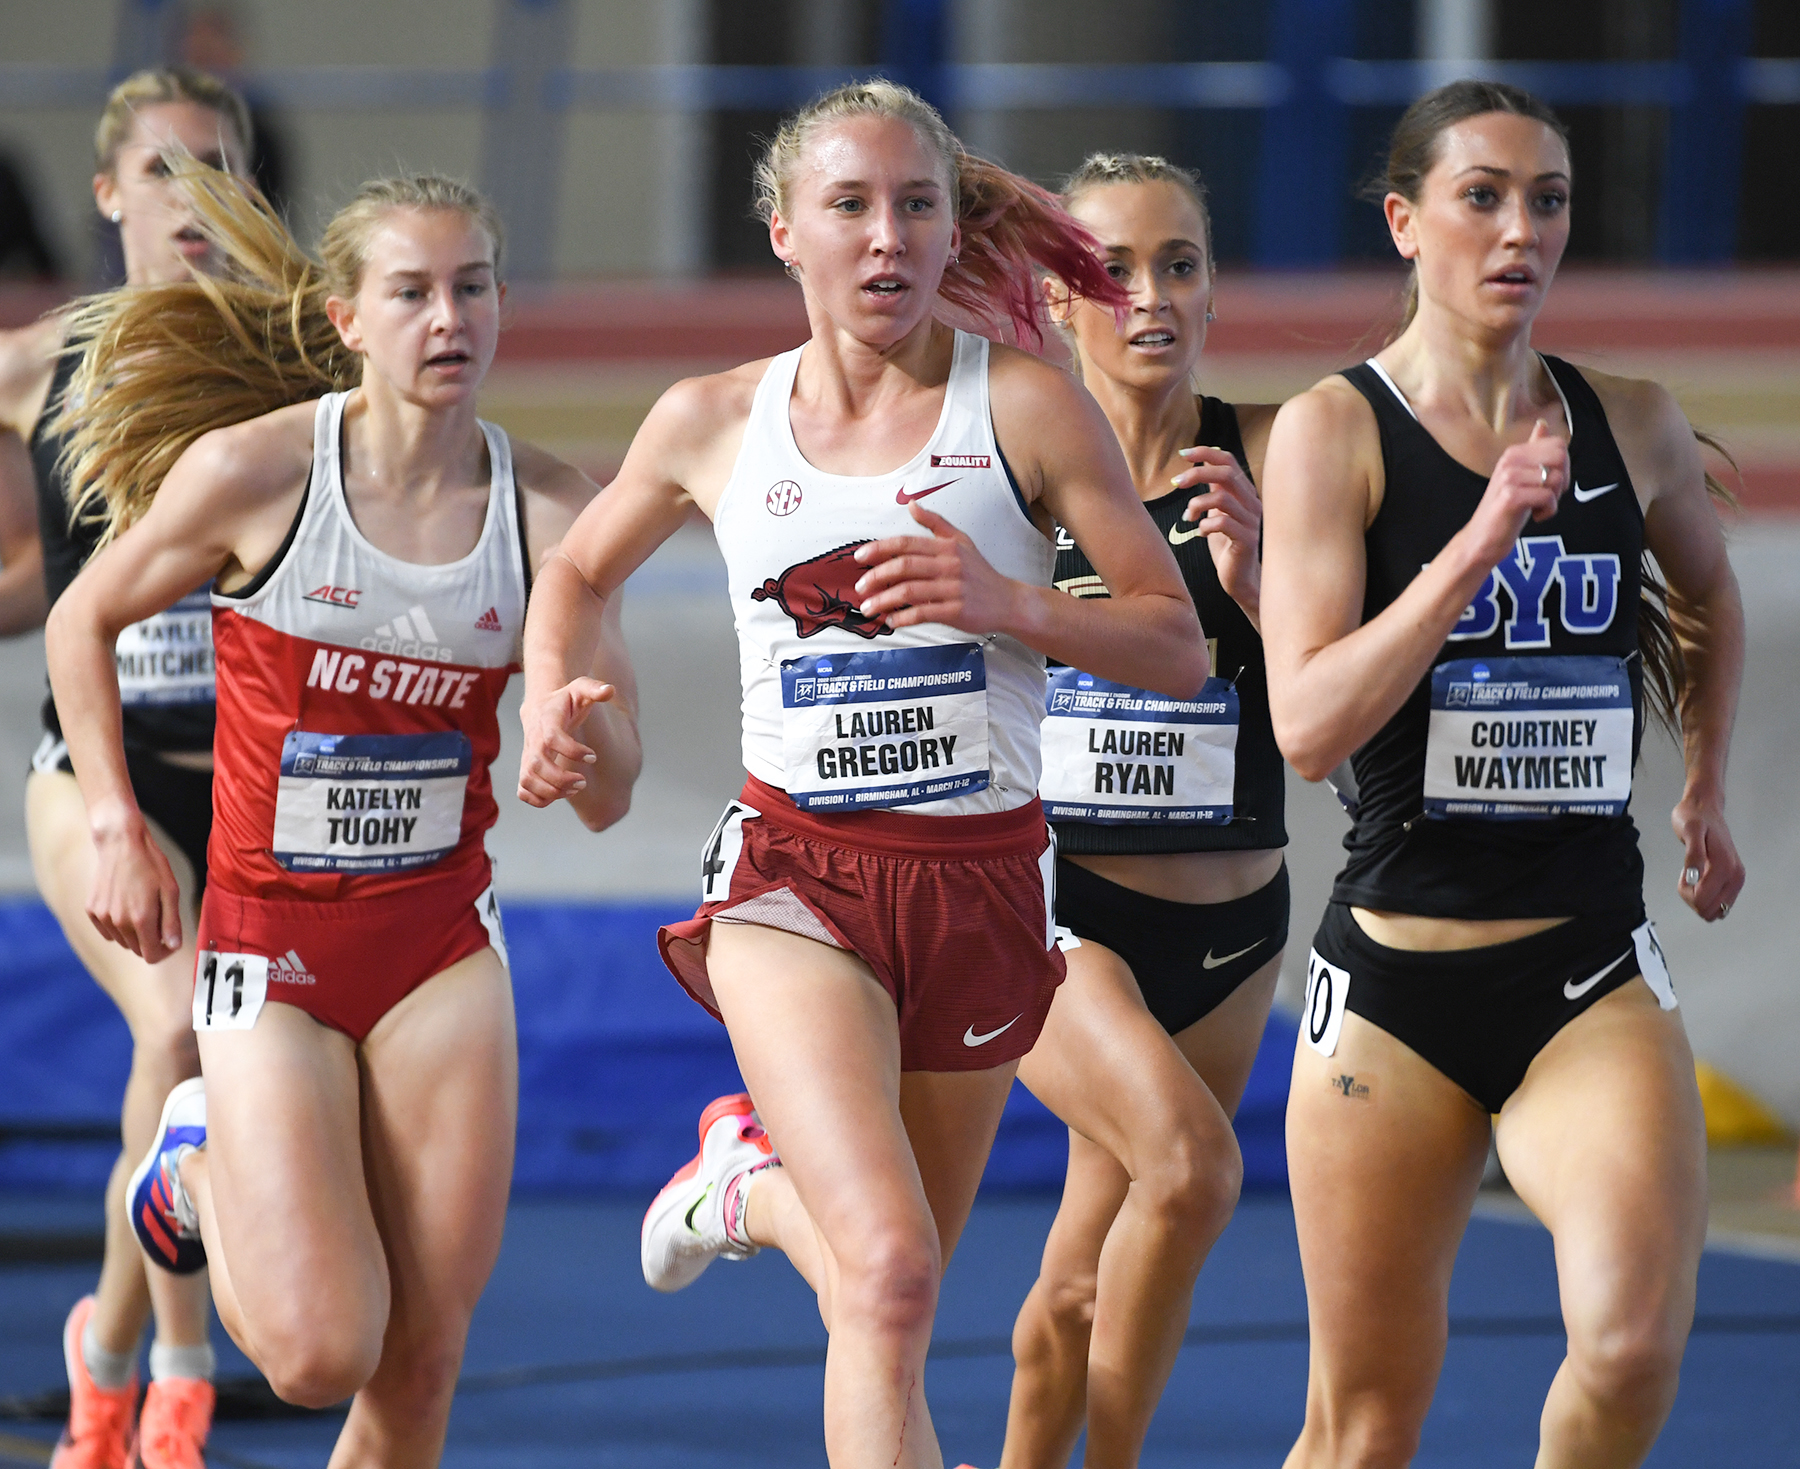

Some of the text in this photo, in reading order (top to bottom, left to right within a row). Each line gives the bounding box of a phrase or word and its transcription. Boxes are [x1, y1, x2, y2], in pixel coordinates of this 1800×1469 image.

[938, 456, 989, 467] EQUALITY
[767, 481, 802, 516] SEC
[309, 585, 362, 606] ACC
[474, 621, 502, 632] adidas
[360, 637, 452, 664] adidas
[306, 648, 481, 709] NC STATE
[816, 670, 972, 694] TRACK & FIELD CHAMPIONSHIPS
[1472, 687, 1504, 699] TRACK
[1514, 686, 1540, 699] FIELD
[1541, 685, 1620, 699] CHAMPIONSHIPS
[1075, 696, 1226, 714] TRACK & FIELD CHAMPIONSHIPS
[835, 706, 934, 739] LAUREN
[1471, 719, 1597, 748] COURTNEY
[1088, 728, 1185, 757] LAUREN
[316, 759, 347, 771] TRACK
[355, 760, 382, 771] FIELD
[383, 757, 459, 772] CHAMPIONSHIPS
[816, 735, 958, 780] GREGORY
[1094, 762, 1175, 796] RYAN
[1454, 755, 1607, 790] WAYMENT
[326, 787, 422, 810] KATELYN
[808, 796, 844, 806] DIVISION
[855, 788, 910, 802] BIRMINGHAM,
[911, 786, 920, 796] AL
[926, 780, 953, 794] MARCH
[954, 777, 970, 788] 11-12
[1052, 806, 1087, 817] DIVISION
[1097, 809, 1151, 820] BIRMINGHAM,
[1151, 811, 1161, 819] AL
[1168, 811, 1197, 820] MARCH
[1197, 810, 1214, 819] 11-12
[327, 816, 417, 846] TUOHY
[292, 856, 326, 867] DIVISION
[703, 805, 743, 894] 4
[203, 957, 245, 1026] 11
